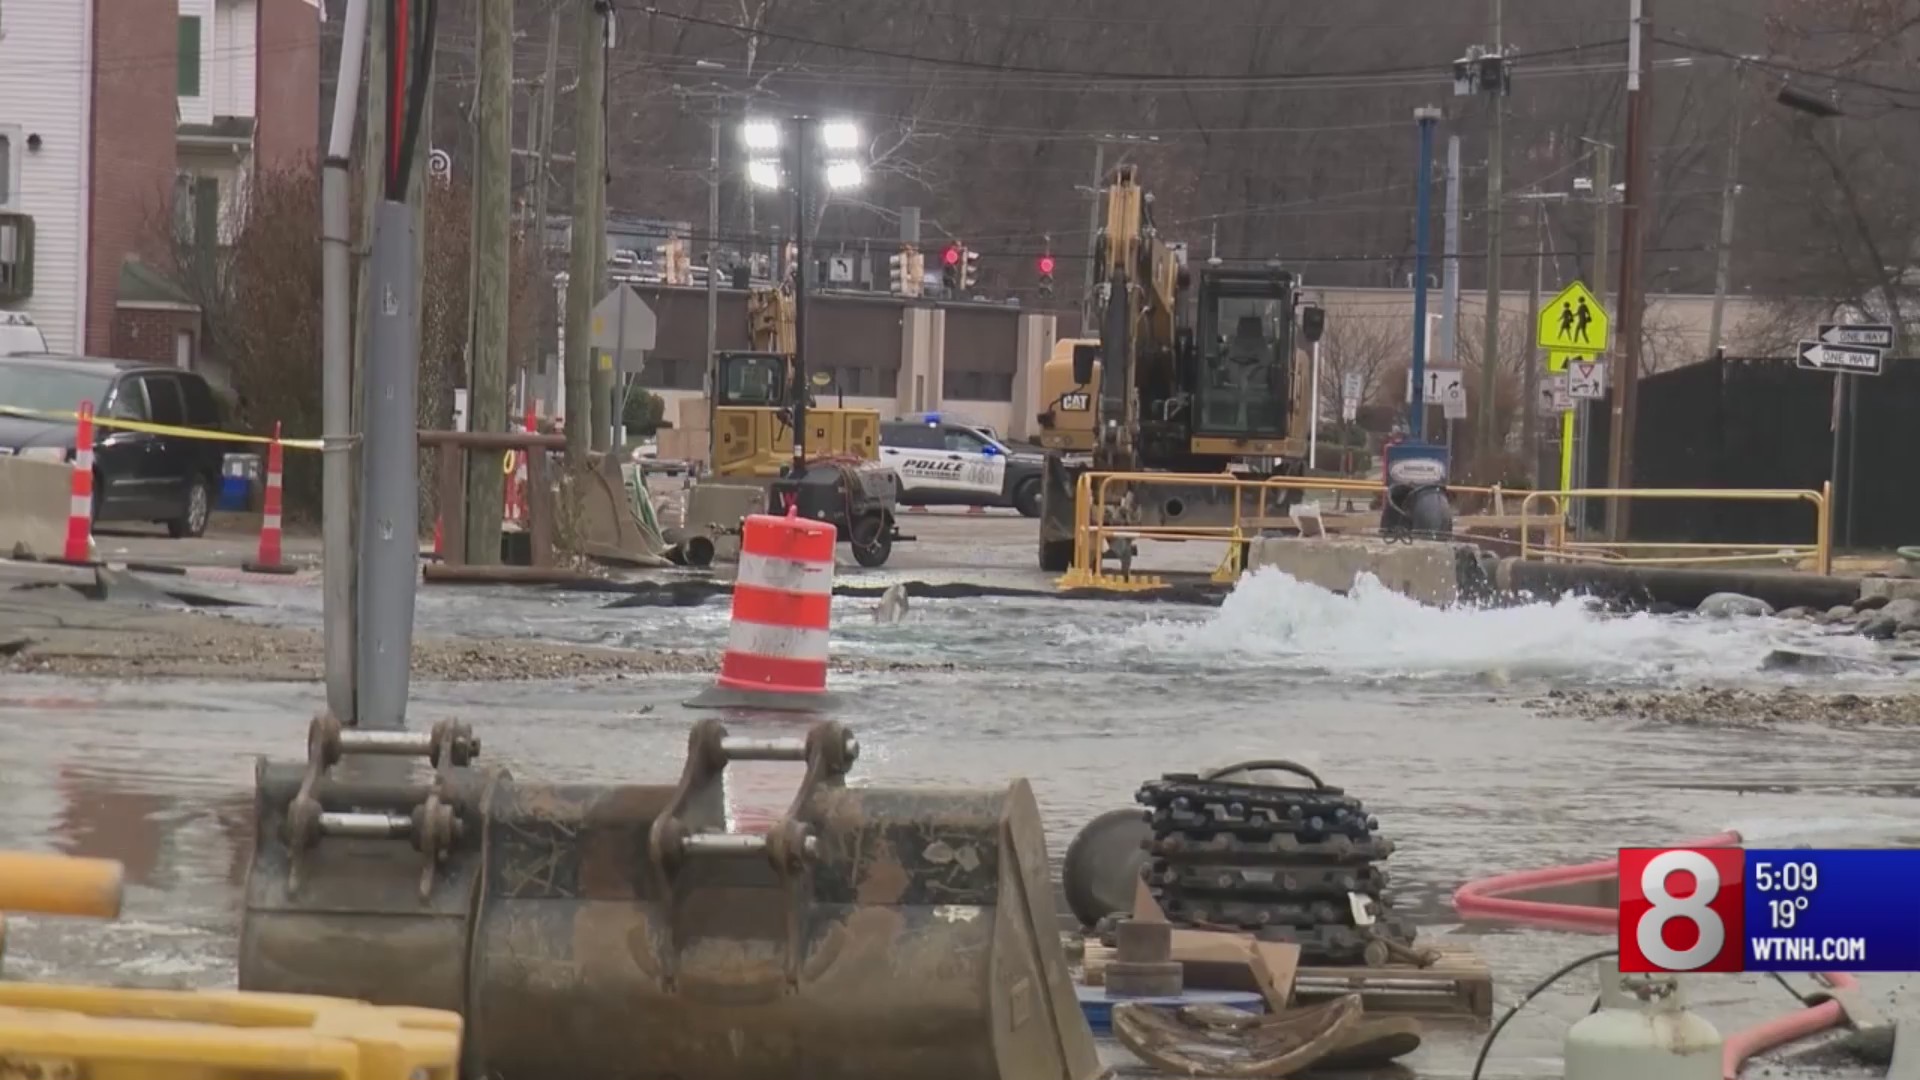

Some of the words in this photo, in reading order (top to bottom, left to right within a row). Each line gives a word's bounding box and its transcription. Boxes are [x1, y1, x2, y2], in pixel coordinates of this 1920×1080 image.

[1840, 331, 1861, 342] ONE
[1864, 332, 1884, 343] WAY
[1823, 350, 1844, 363] ONE
[1848, 353, 1872, 366] WAY
[1062, 395, 1088, 410] CAT
[903, 459, 965, 472] POLICE
